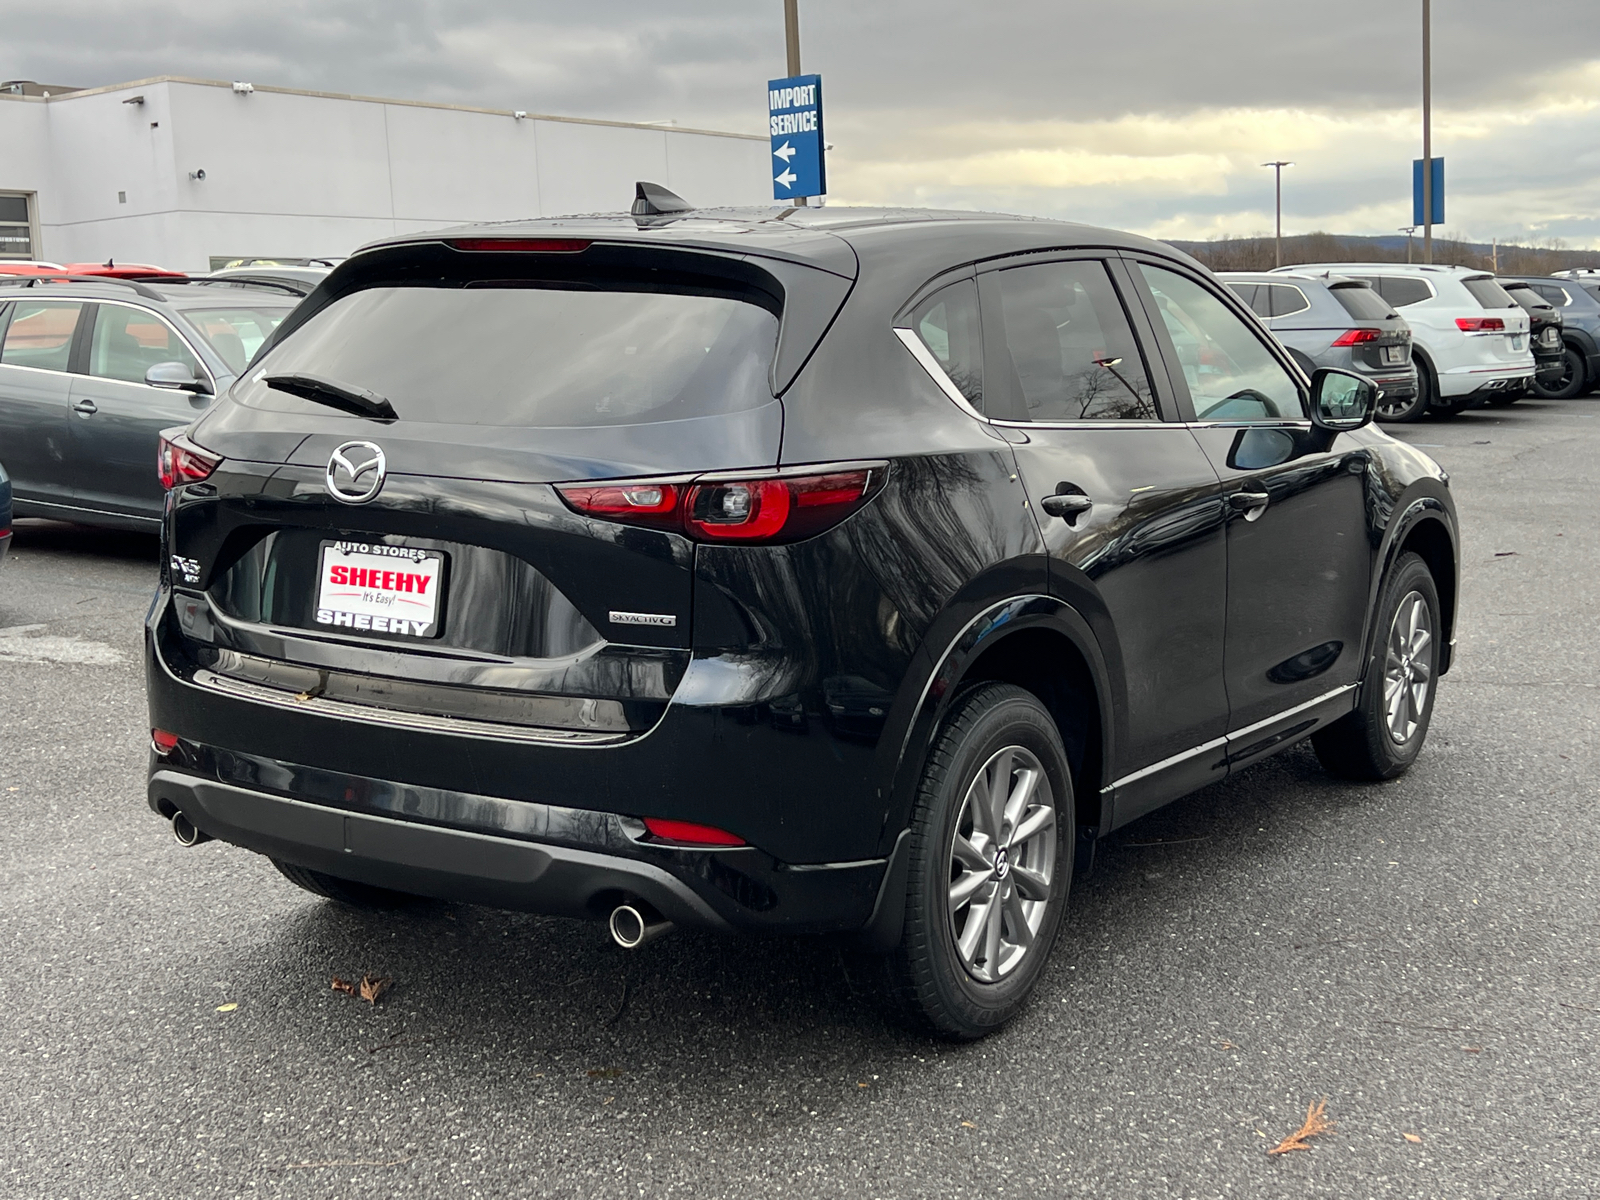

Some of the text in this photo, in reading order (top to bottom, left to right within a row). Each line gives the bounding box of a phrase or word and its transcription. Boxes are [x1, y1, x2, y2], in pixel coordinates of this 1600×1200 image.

[769, 84, 816, 111] IMPORT
[770, 110, 818, 136] SERVICE
[333, 540, 426, 560] AUTO STORES
[329, 565, 432, 594] SHEEHY
[362, 591, 397, 607] It's Easy!
[316, 609, 431, 637] SHEEHY
